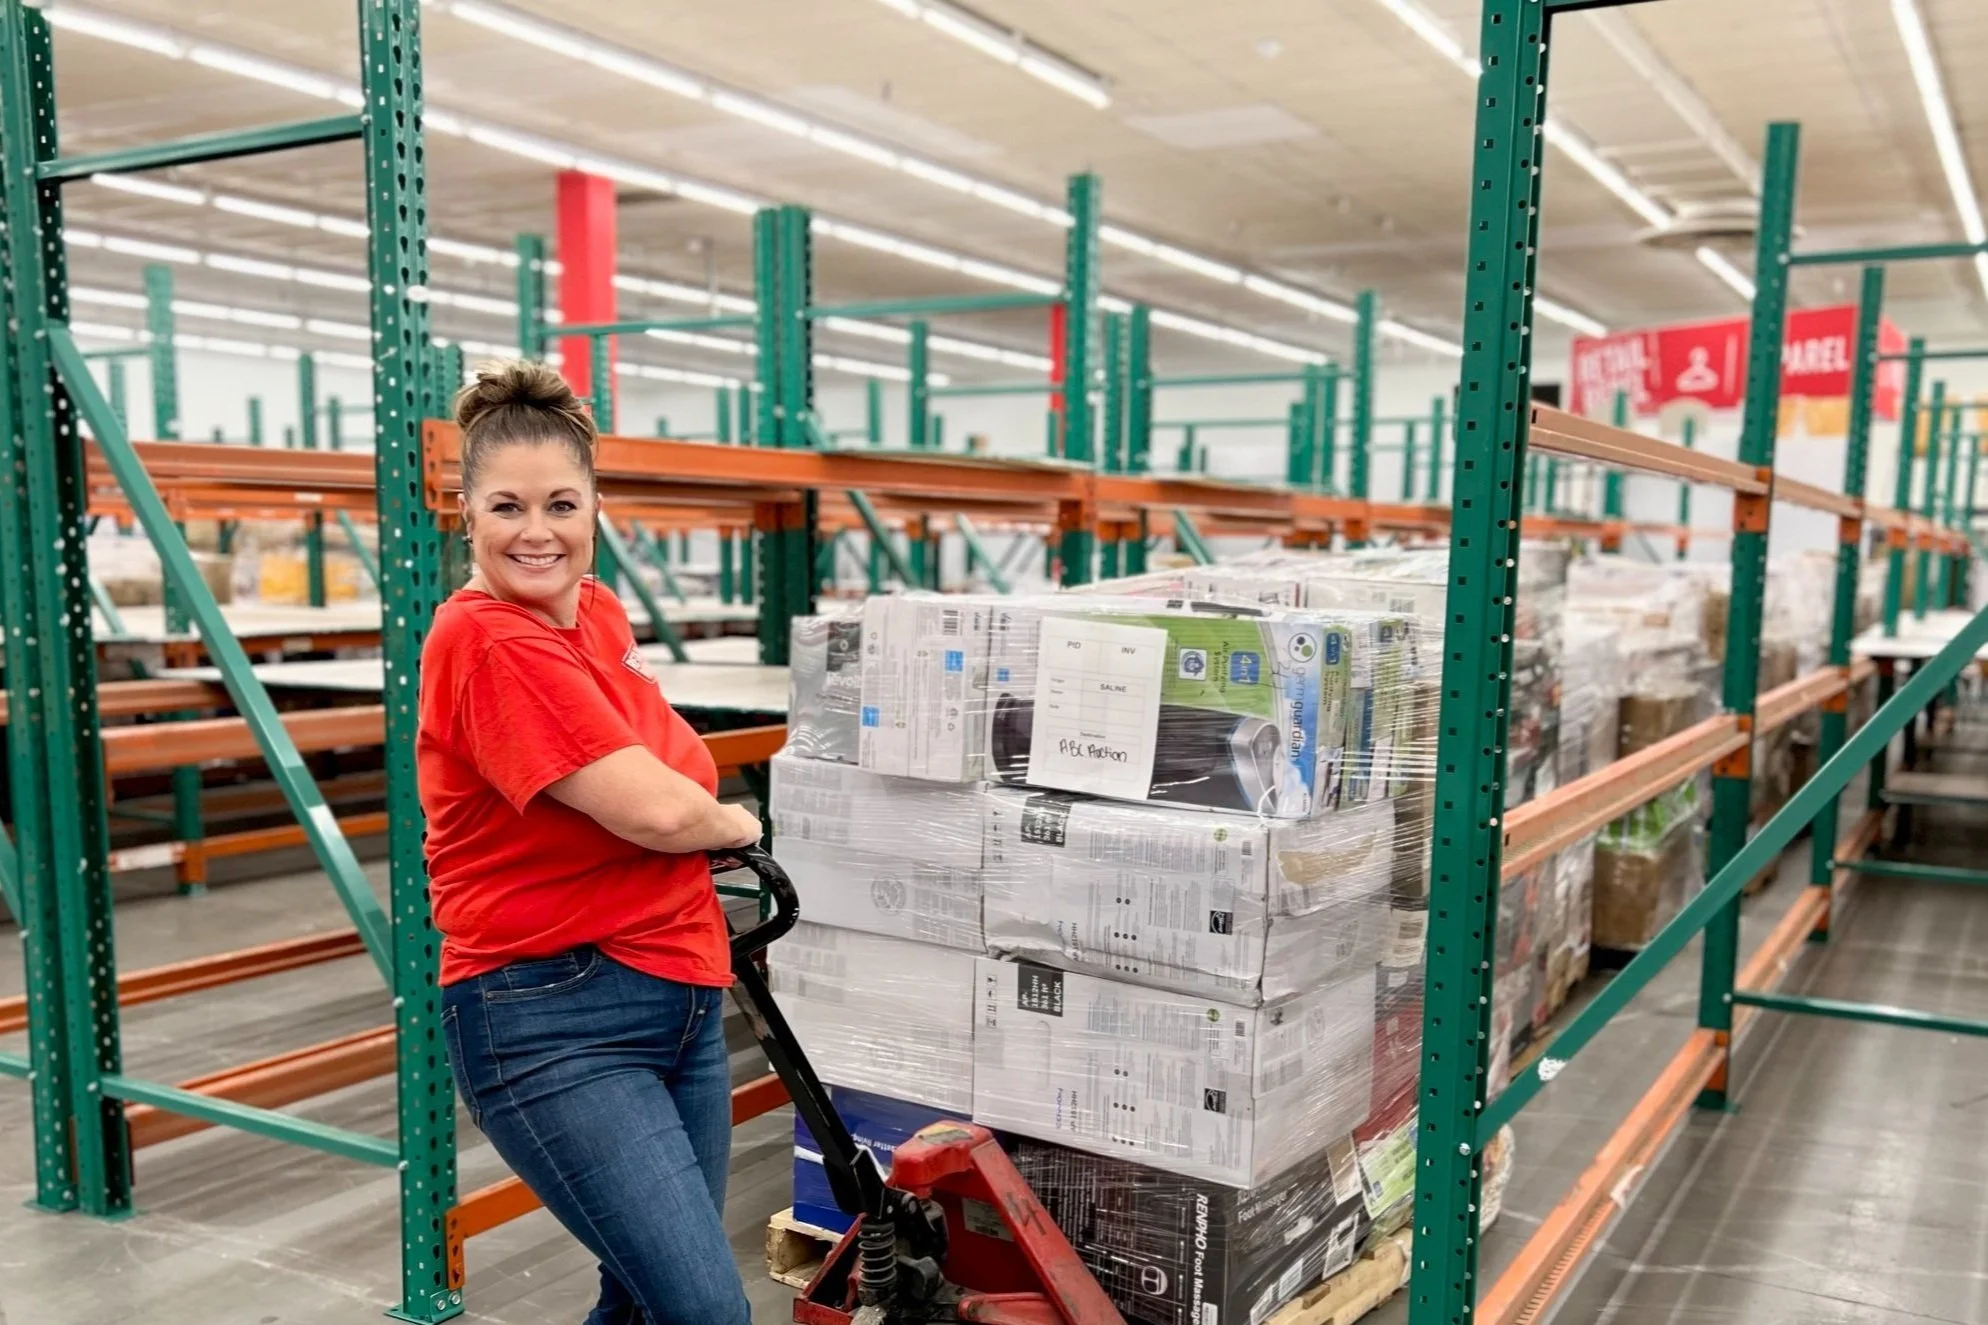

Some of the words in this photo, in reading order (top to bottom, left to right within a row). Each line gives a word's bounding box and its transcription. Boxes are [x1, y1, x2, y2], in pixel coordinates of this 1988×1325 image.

[1782, 335, 1850, 376] PAREL
[1067, 641, 1081, 650] PID
[1121, 647, 1136, 655] INV
[1100, 683, 1127, 693] SALINE
[1059, 739, 1085, 757] ABC
[1056, 811, 1067, 843] BLACK
[1053, 981, 1062, 1013] BLACK
[1195, 1193, 1209, 1250] RENPHO
[1238, 1206, 1256, 1224] Foot
[1194, 1251, 1205, 1276] Foot
[1190, 1277, 1204, 1325] Massage
